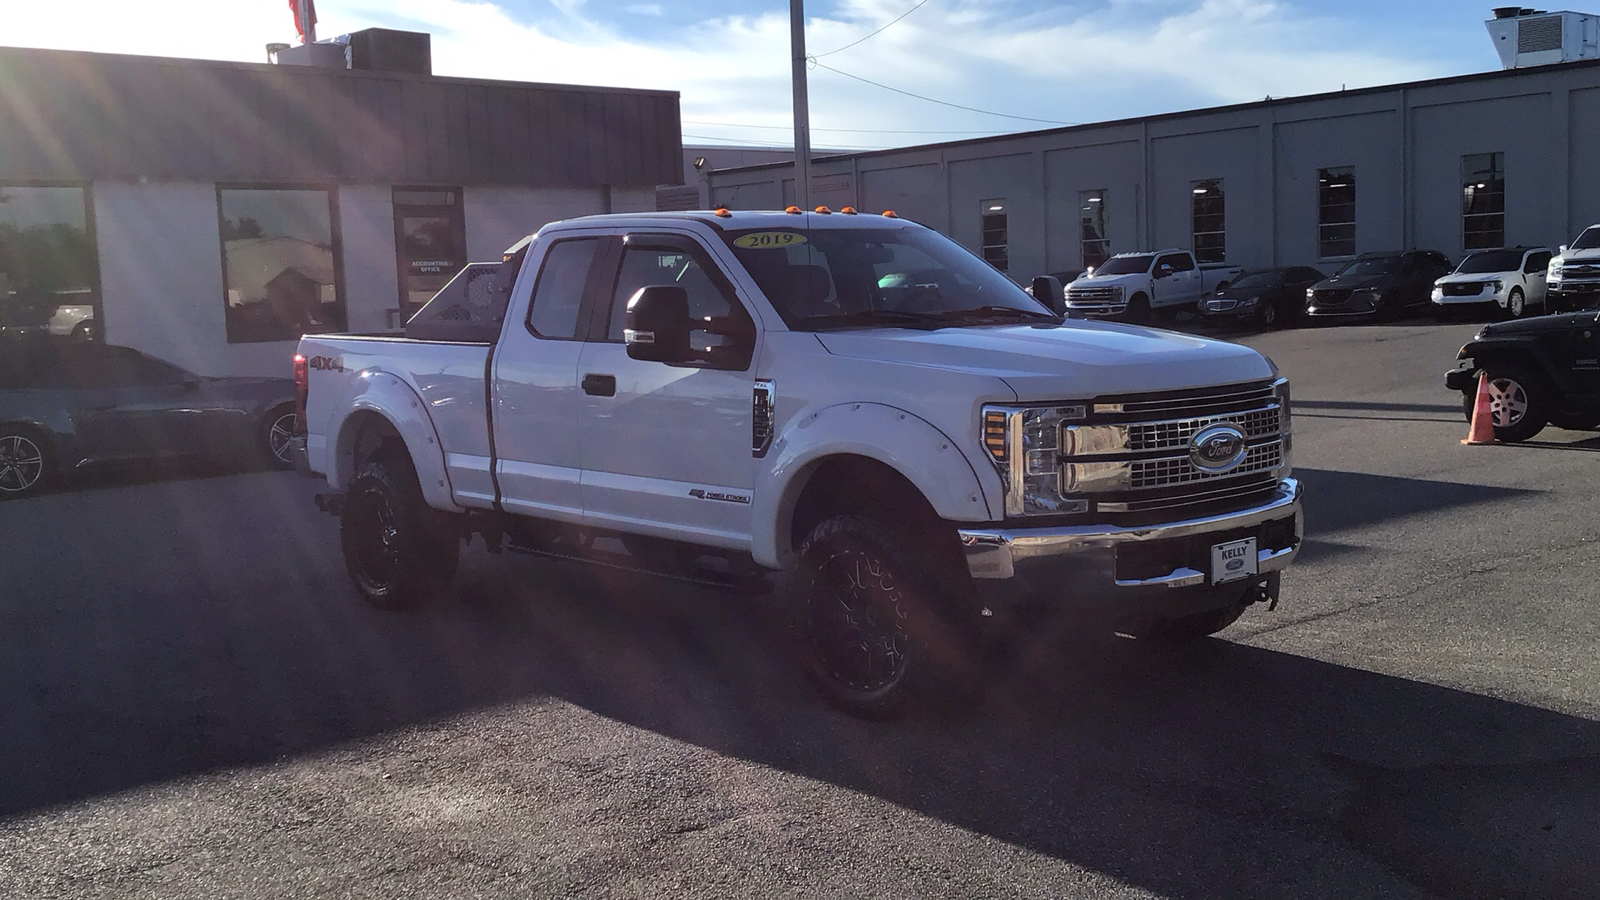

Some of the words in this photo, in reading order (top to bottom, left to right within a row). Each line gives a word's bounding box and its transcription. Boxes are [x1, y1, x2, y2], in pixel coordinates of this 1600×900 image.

[749, 233, 793, 247] 2019
[1208, 438, 1233, 457] Ford
[1222, 546, 1247, 560] KELLY
